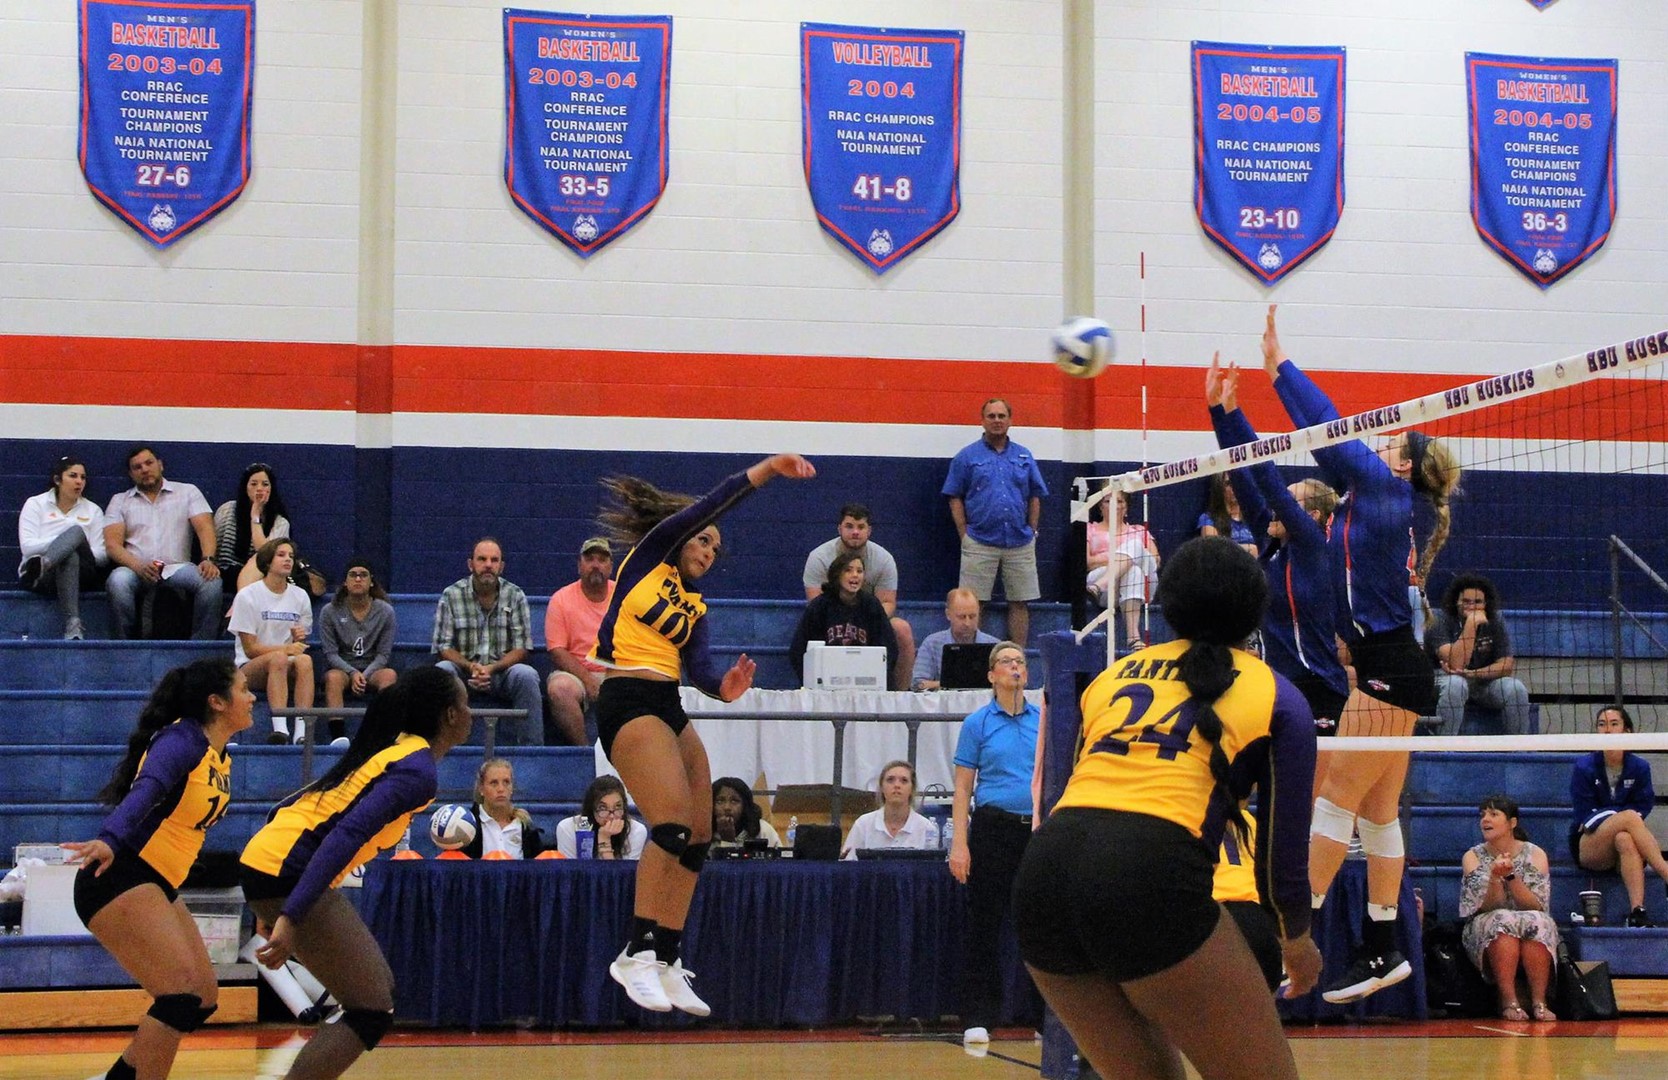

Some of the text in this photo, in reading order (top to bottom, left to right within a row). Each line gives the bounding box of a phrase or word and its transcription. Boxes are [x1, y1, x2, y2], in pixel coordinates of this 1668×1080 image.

[147, 14, 188, 24] MEN'S
[111, 22, 220, 49] BASKETBALL
[563, 29, 616, 39] WOMEN'S
[538, 36, 640, 62] BASKETBALL
[832, 41, 932, 69] VOLLEYBALL
[107, 53, 223, 76] 2003-04
[1250, 65, 1288, 74] MEN'S
[528, 68, 638, 89] 2003-04
[1519, 71, 1567, 81] WOMEN'S
[147, 80, 184, 92] RRAC
[848, 79, 916, 99] 2004
[1221, 72, 1318, 98] BASKETBALL
[1497, 79, 1589, 104] BASKETBALL
[121, 90, 209, 105] CONFERENCE
[570, 91, 605, 103] RRAC
[120, 107, 209, 122] TOURNAMENT
[544, 103, 627, 116] CONFERENCE
[1216, 103, 1322, 124] 2004-05
[544, 119, 628, 132] TOURNAMENT
[828, 110, 935, 126] RRAC CHAMPIONS
[1493, 108, 1593, 130] 2004-05
[125, 120, 203, 134] CHAMPIONS
[114, 136, 213, 150] NAIA NATIONAL
[550, 131, 623, 144] CHAMPIONS
[837, 129, 927, 144] NAIA NATIONAL
[1528, 131, 1560, 143] RRAC
[540, 146, 633, 160] NAIA NATIONAL
[841, 141, 922, 156] TOURNAMENT
[1216, 139, 1321, 153] RRAC CHAMPIONS
[1504, 142, 1580, 155] CONFERENCE
[120, 149, 208, 162] TOURNAMENT
[544, 159, 628, 173] TOURNAMENT
[1224, 158, 1313, 171] NAIA NATIONAL
[1505, 157, 1581, 171] TOURNAMENT
[137, 164, 191, 187] 27-6
[1229, 170, 1309, 183] TOURNAMENT
[1510, 169, 1577, 182] CHAMPIONS
[559, 175, 610, 198] 33-5
[853, 174, 912, 201] 41-8
[1502, 183, 1587, 197] NAIA NATIONAL
[1505, 195, 1582, 209] TOURNAMENT
[1239, 207, 1300, 230] 23-10
[1522, 211, 1568, 232] 36-3
[1586, 346, 1619, 373] HBU
[1444, 368, 1535, 410] HBU HUSKIES
[1326, 405, 1401, 439] HBU HUSKIES
[1251, 434, 1292, 459] HUSKIES
[634, 592, 690, 645] 10
[352, 636, 364, 656] 4
[1088, 683, 1198, 762] 24
